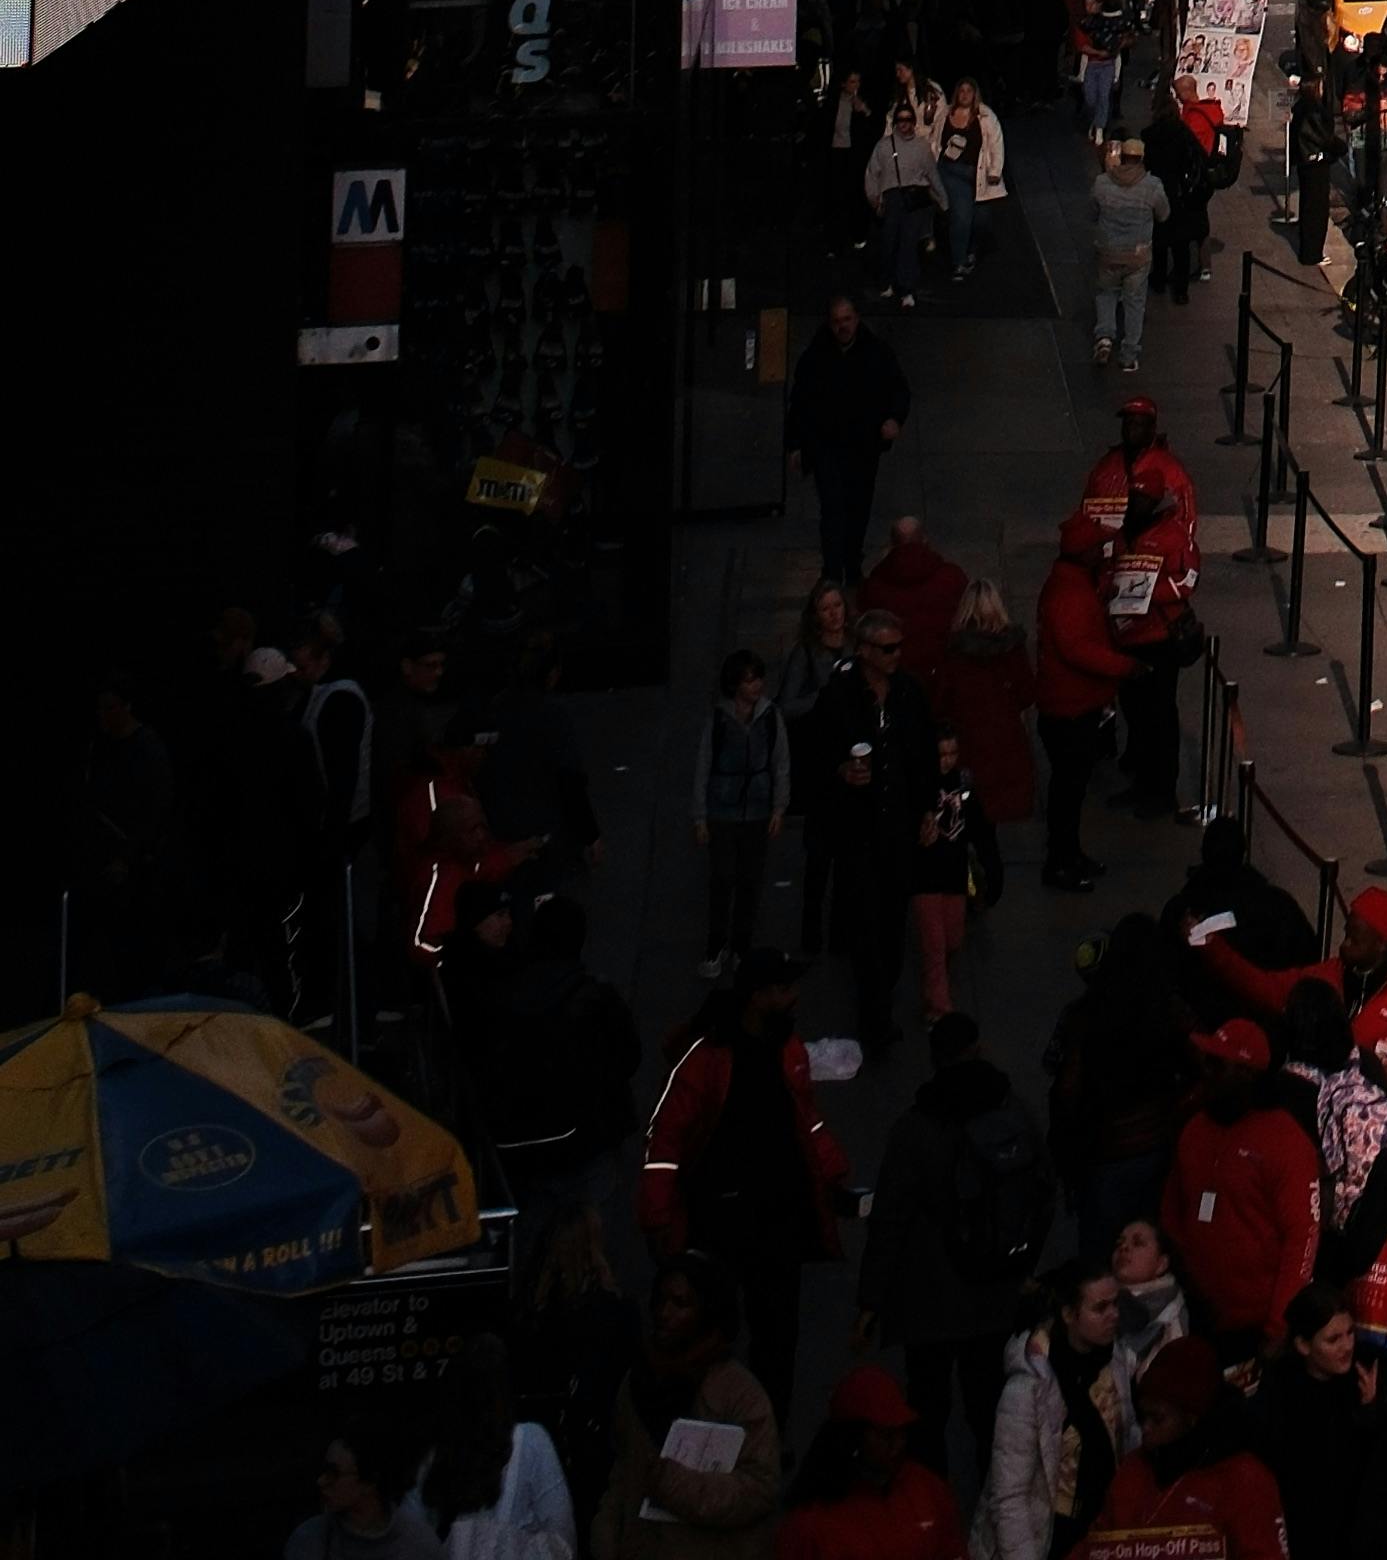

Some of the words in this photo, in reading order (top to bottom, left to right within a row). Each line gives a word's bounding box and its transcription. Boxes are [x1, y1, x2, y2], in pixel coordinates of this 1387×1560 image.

[261, 1239, 311, 1271] ROLL
[408, 1295, 430, 1311] to
[321, 1319, 397, 1344] Uptown
[320, 1344, 397, 1368] Queens
[320, 1369, 340, 1390] at
[346, 1365, 375, 1386] 49
[385, 1362, 404, 1385] St
